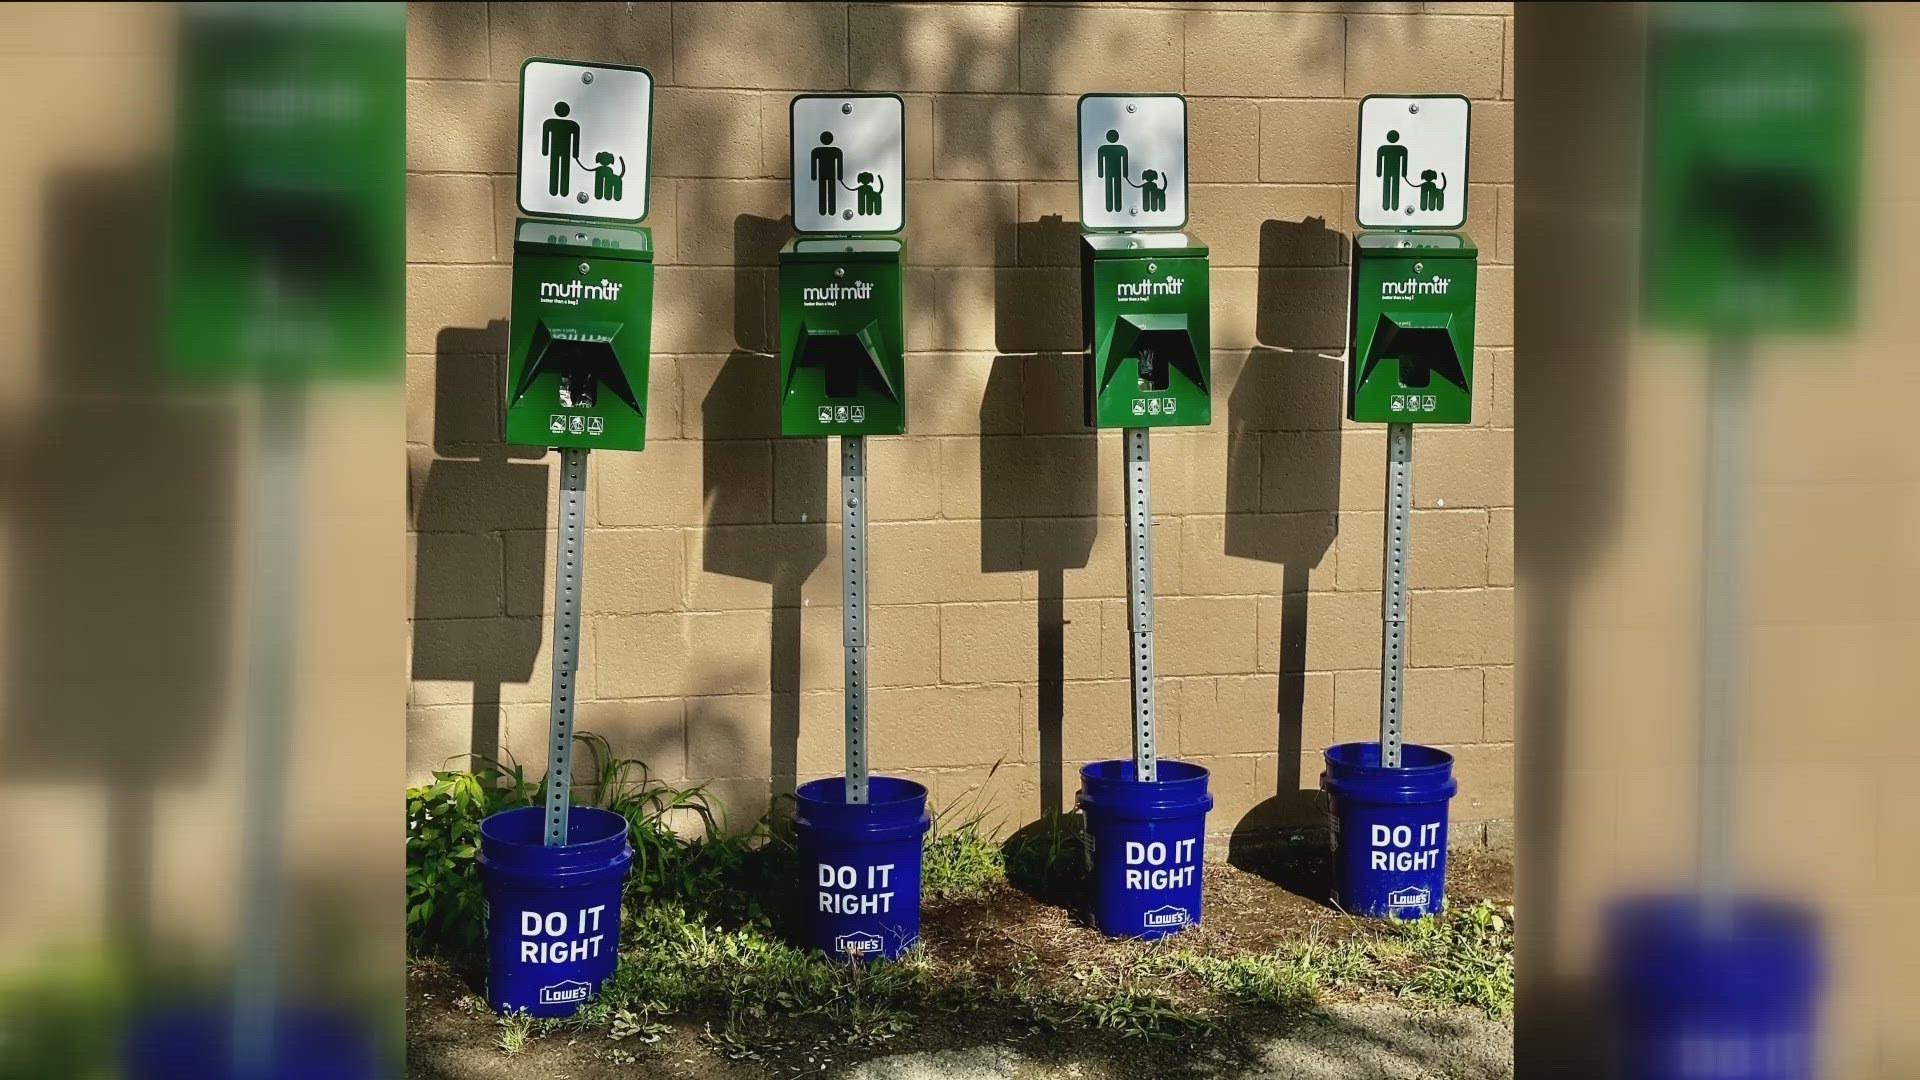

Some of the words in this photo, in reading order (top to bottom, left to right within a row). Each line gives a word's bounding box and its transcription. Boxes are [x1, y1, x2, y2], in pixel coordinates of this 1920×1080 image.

[541, 280, 583, 298] mutt
[584, 279, 620, 301] mitt
[804, 283, 840, 300] mutt
[841, 280, 872, 300] mitt
[1118, 279, 1152, 296] mutt
[1153, 276, 1182, 295] mitt
[1382, 278, 1417, 294] mutt
[1418, 275, 1448, 294] mitt
[1372, 824, 1412, 848] DO
[1420, 822, 1440, 847] IT
[1126, 841, 1167, 865] DO
[1175, 838, 1196, 864] IT
[1371, 848, 1439, 872] RIGHT
[819, 863, 857, 890] DO
[868, 863, 895, 889] IT
[1126, 865, 1195, 890] RIGHT
[819, 891, 895, 915] RIGHT
[1393, 892, 1428, 905] LOWE'S
[521, 910, 568, 937] DO
[578, 905, 605, 934] IT
[1149, 912, 1185, 925] LOWE'S
[521, 934, 604, 964] RIGHT
[545, 986, 588, 1002] LOWE'S
